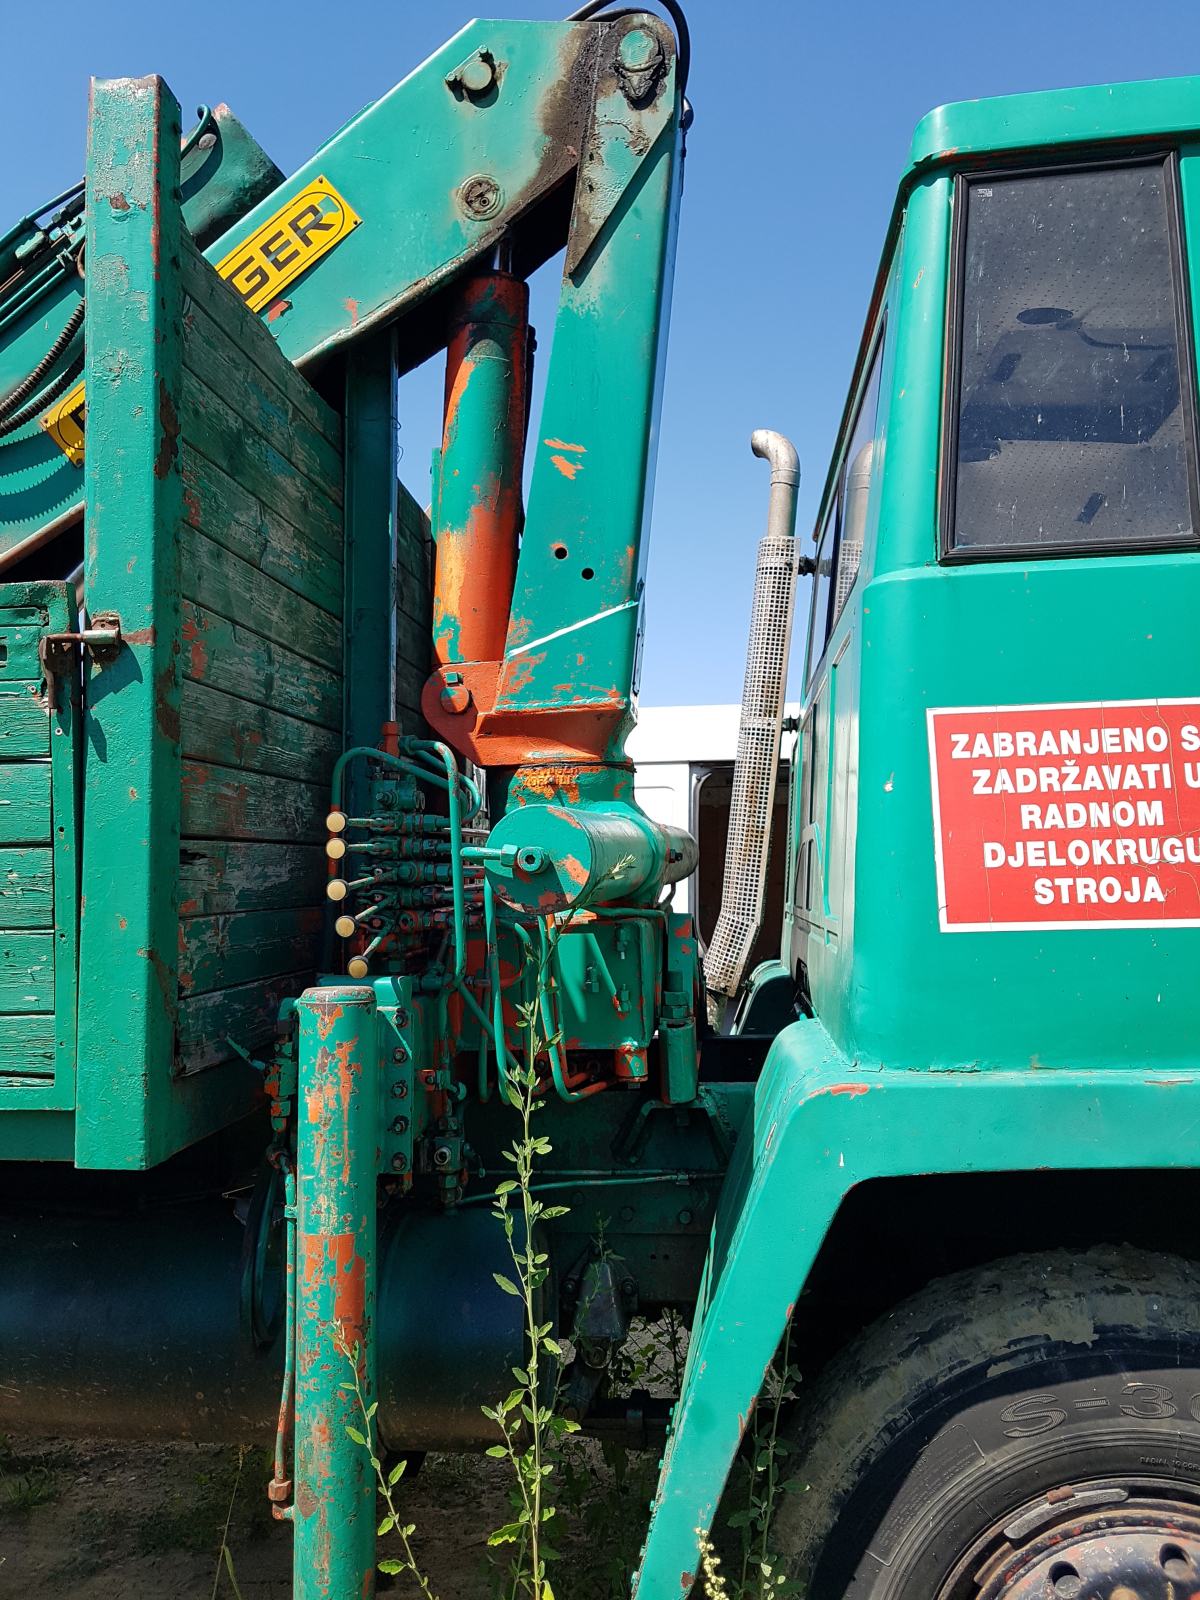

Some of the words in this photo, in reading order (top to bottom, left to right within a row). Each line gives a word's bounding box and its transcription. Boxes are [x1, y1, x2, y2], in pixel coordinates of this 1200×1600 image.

[951, 726, 1168, 759] ZABRANJENO
[972, 759, 1172, 795] ZADRŽAVATI
[1020, 801, 1164, 830] RADNOM
[984, 837, 1200, 868] DJELOKRUGU
[1034, 876, 1166, 905] STROJA
